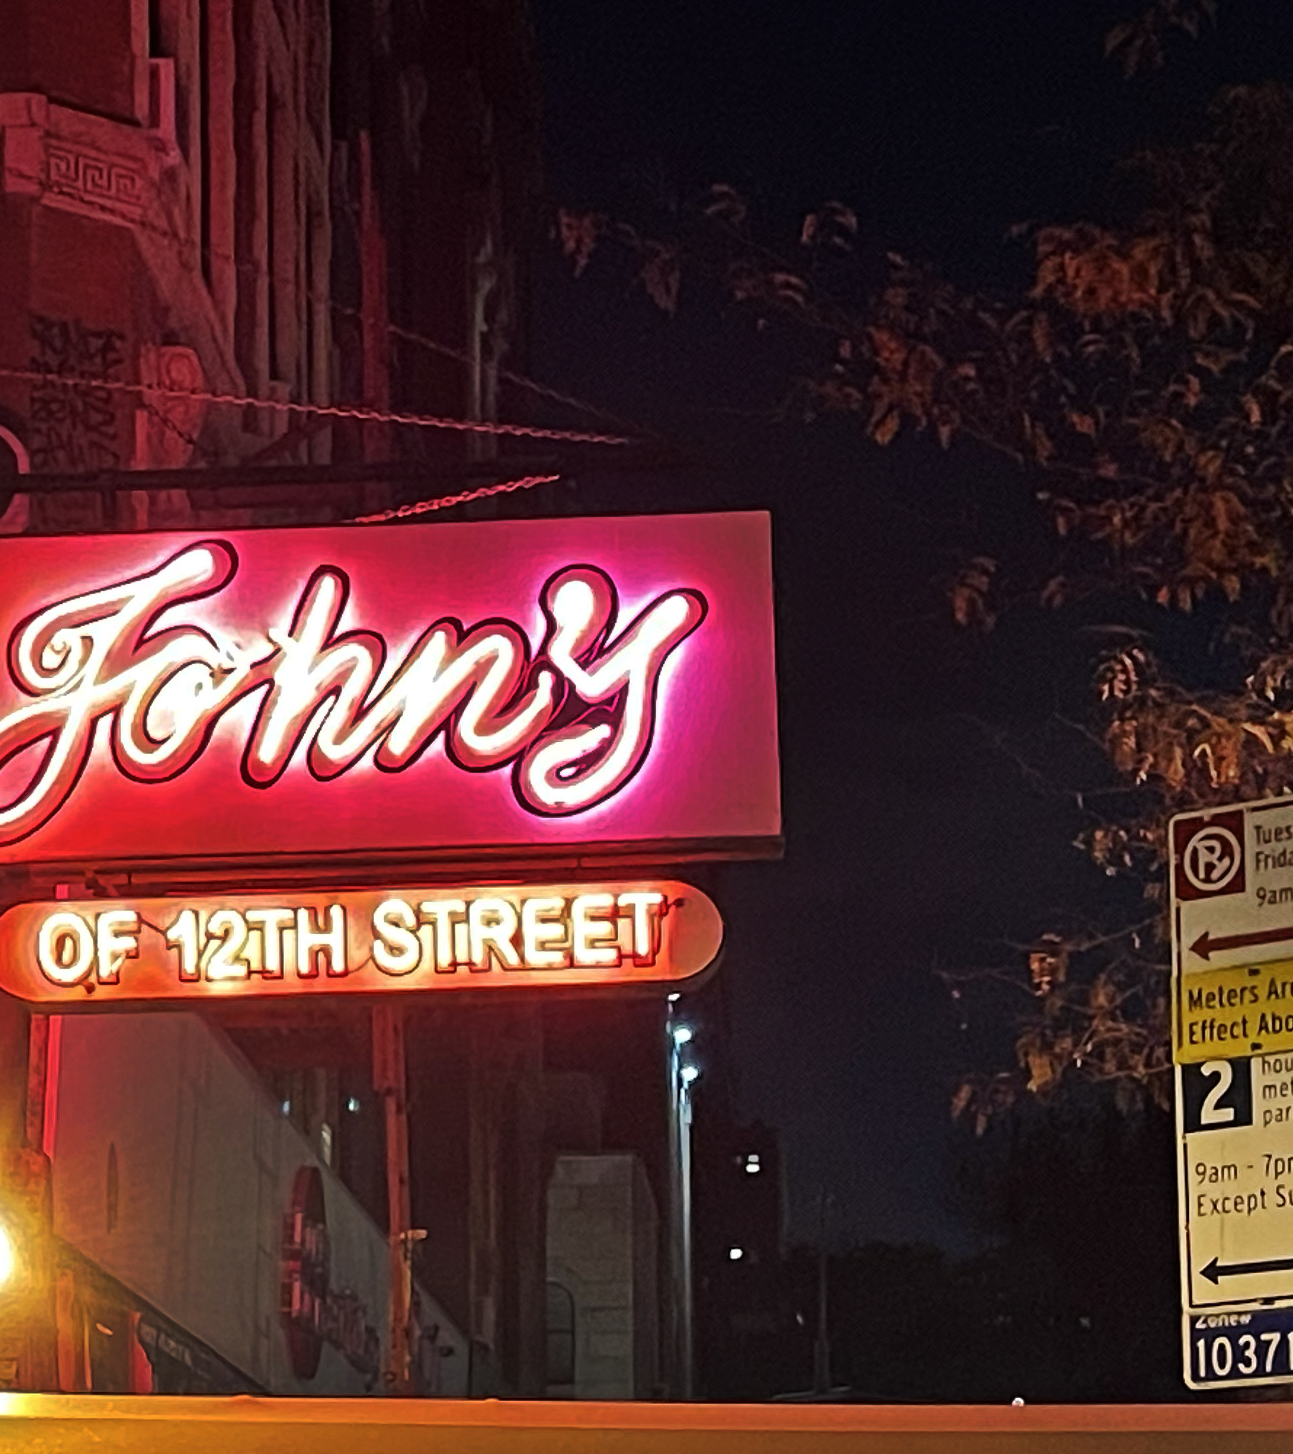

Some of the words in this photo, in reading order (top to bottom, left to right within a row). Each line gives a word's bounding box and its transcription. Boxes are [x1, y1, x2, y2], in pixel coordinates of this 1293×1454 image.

[37, 909, 139, 986] OF
[167, 903, 346, 982] 12TH
[371, 891, 665, 974] STREET
[1188, 984, 1259, 1012] Meters
[1188, 1015, 1248, 1045] Effect
[1200, 1060, 1235, 1125] 2
[1195, 1162, 1238, 1186] 9am
[1197, 1187, 1267, 1217] Except
